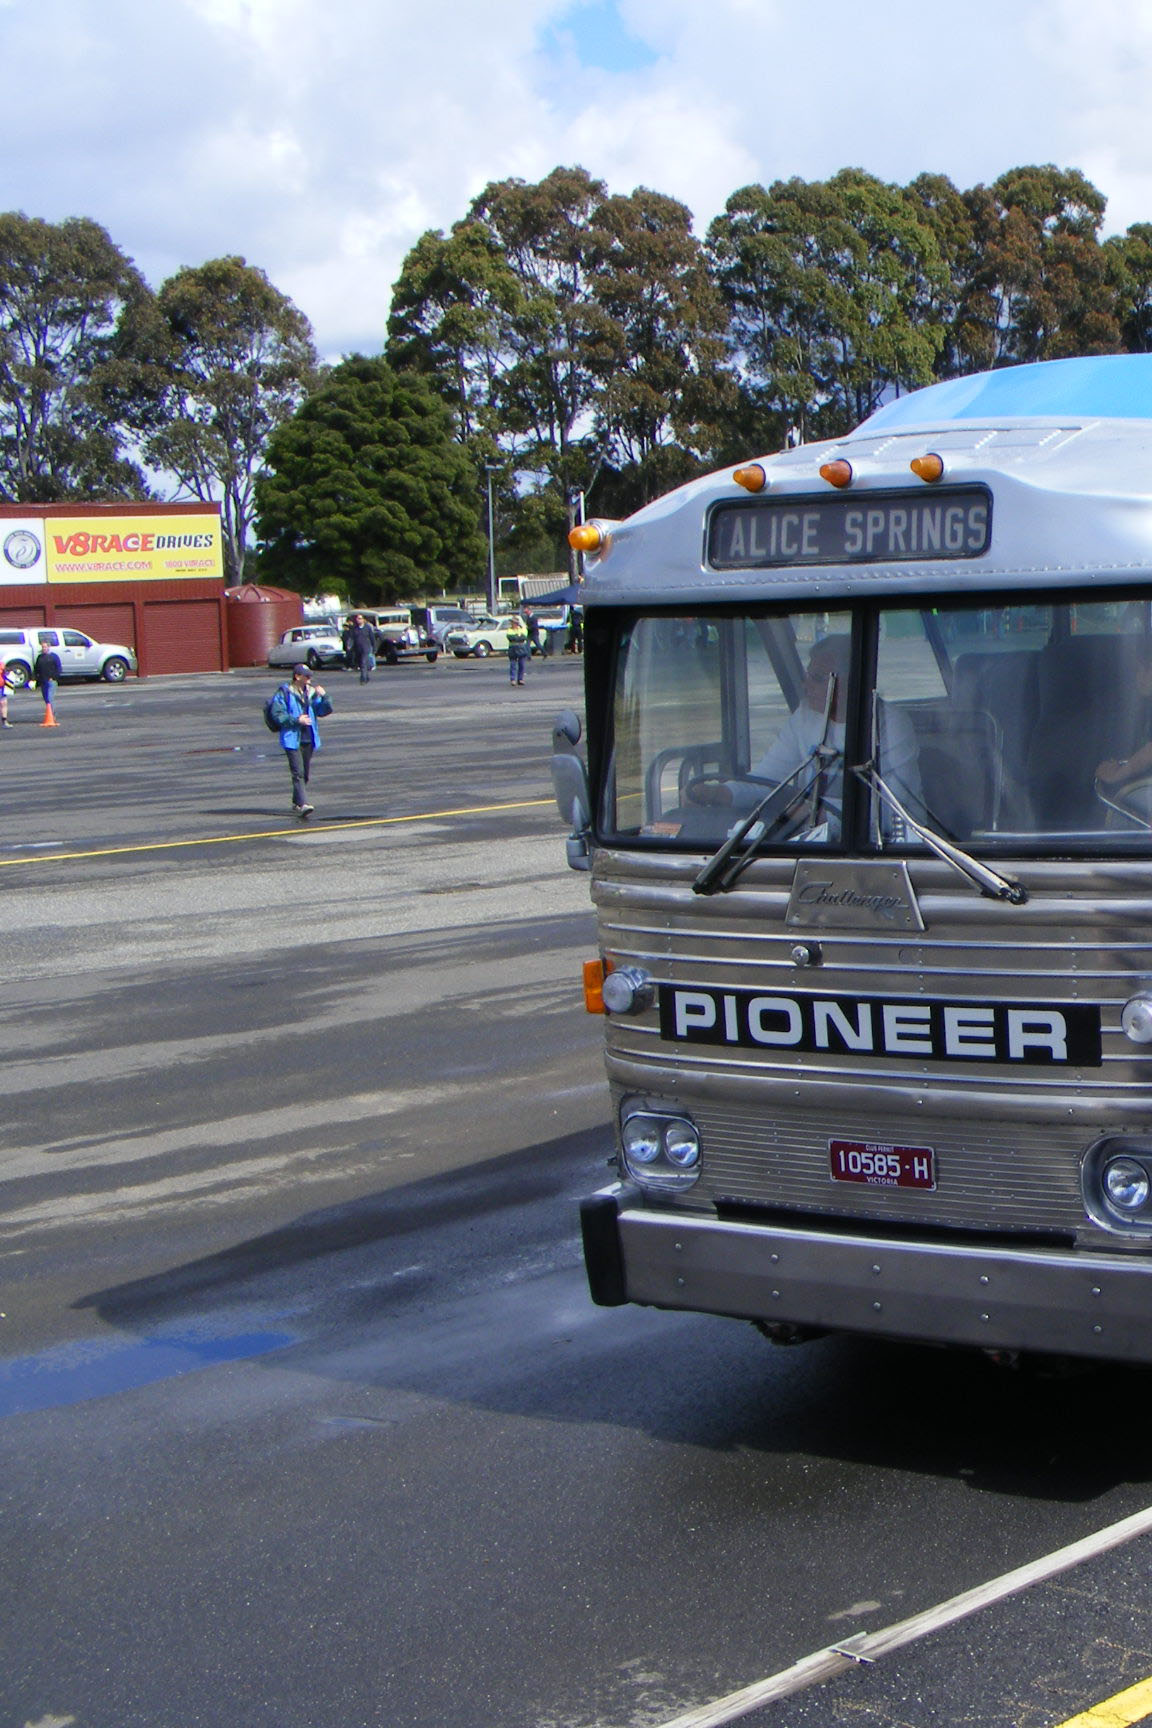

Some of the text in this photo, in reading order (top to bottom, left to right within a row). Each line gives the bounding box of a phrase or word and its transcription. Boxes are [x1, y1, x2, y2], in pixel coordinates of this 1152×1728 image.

[729, 505, 988, 557] ALICE SPRINGS
[798, 881, 909, 919] Challenger
[674, 990, 1068, 1060] PIONEER
[866, 1176, 898, 1186] VICTORIA
